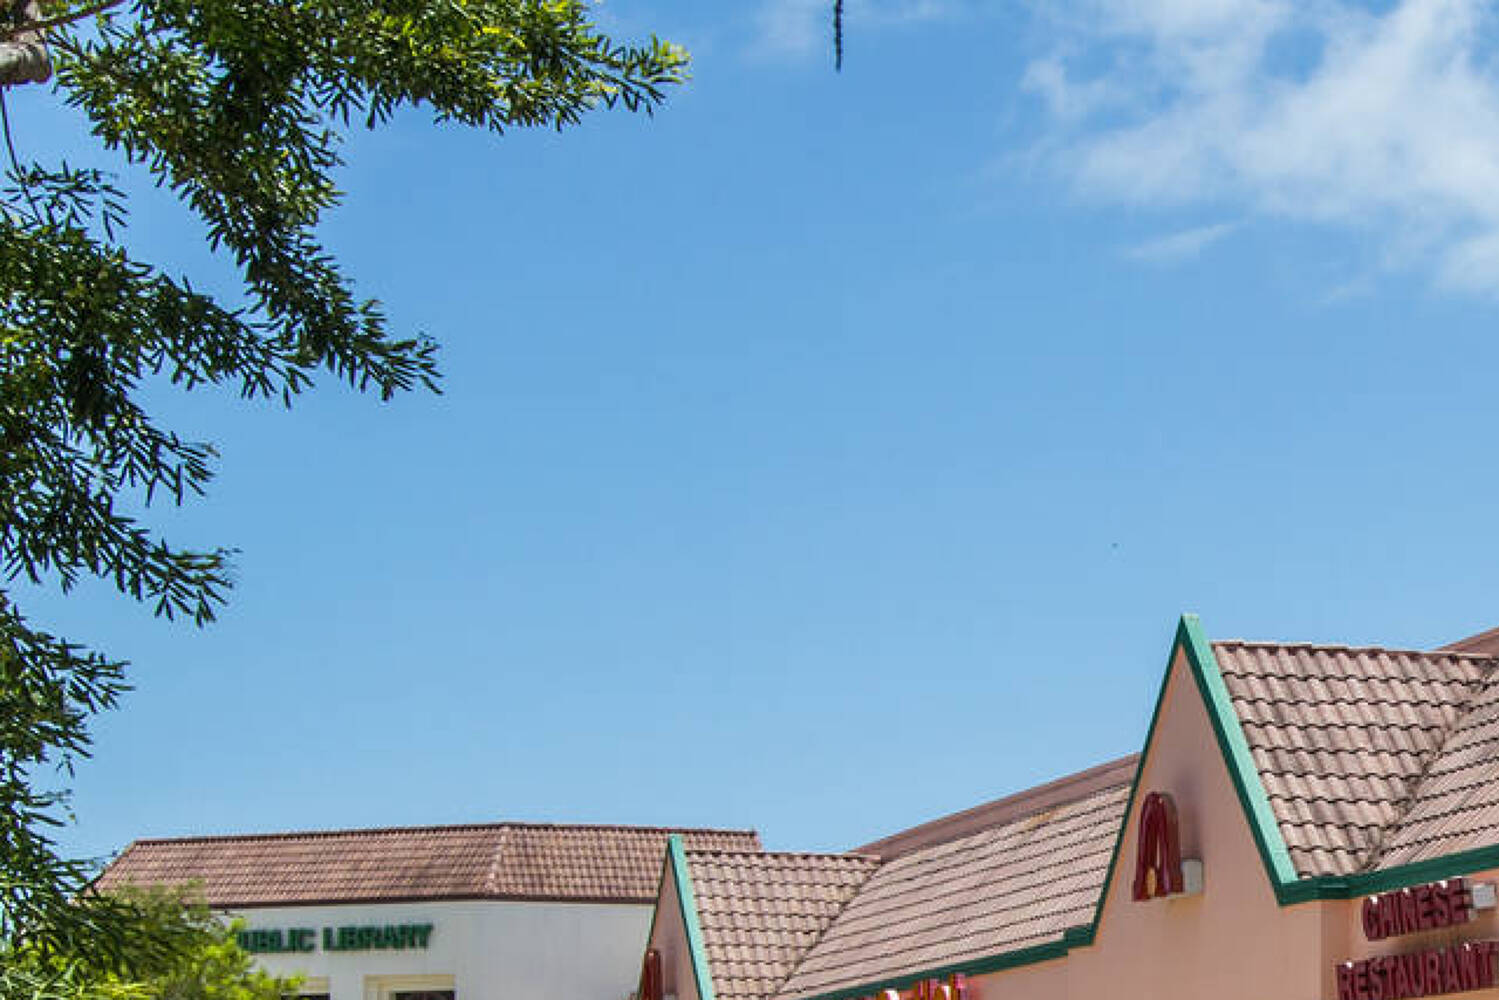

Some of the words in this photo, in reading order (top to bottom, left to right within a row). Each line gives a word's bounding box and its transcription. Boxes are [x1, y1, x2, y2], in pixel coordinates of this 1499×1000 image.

[1363, 877, 1469, 941] CHINESE
[236, 928, 316, 953] UBLIC
[322, 922, 433, 951] LIBRARY
